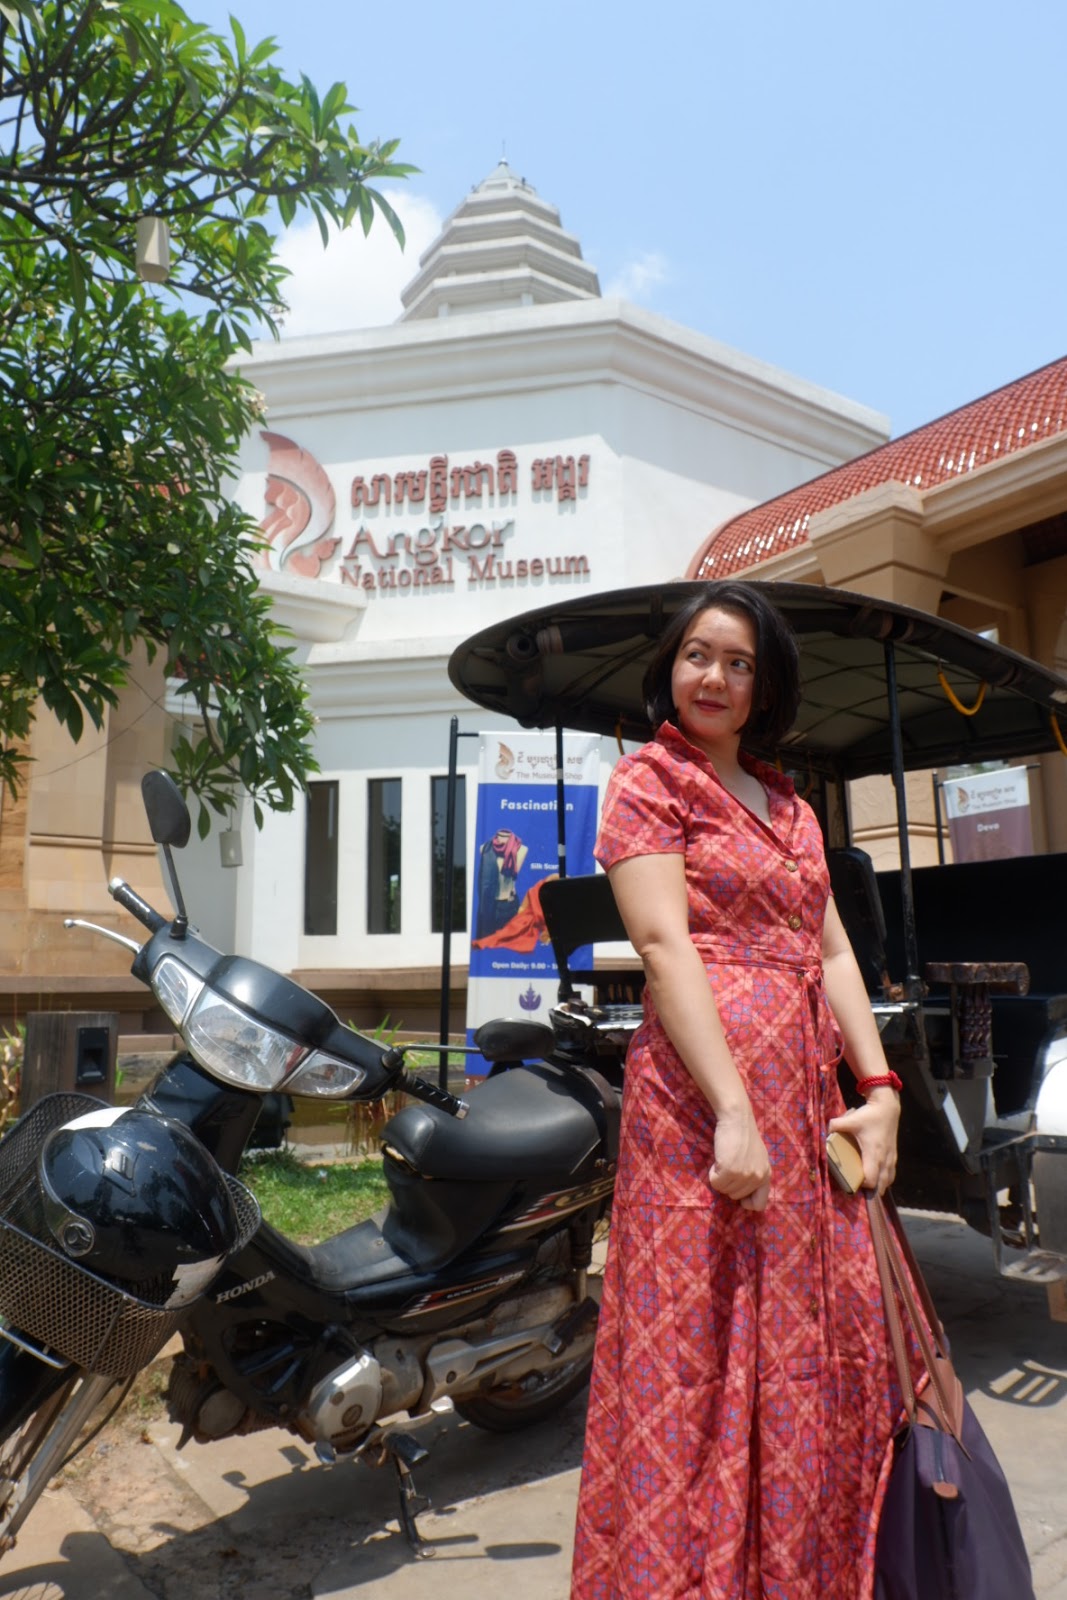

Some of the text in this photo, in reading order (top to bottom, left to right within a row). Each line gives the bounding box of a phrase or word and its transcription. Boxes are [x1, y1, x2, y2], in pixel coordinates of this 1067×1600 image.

[343, 515, 516, 567] Angkor
[339, 553, 591, 590] National Museum
[532, 772, 558, 780] Museu
[501, 799, 574, 811] Fascinatin
[216, 1270, 276, 1305] HONDA
